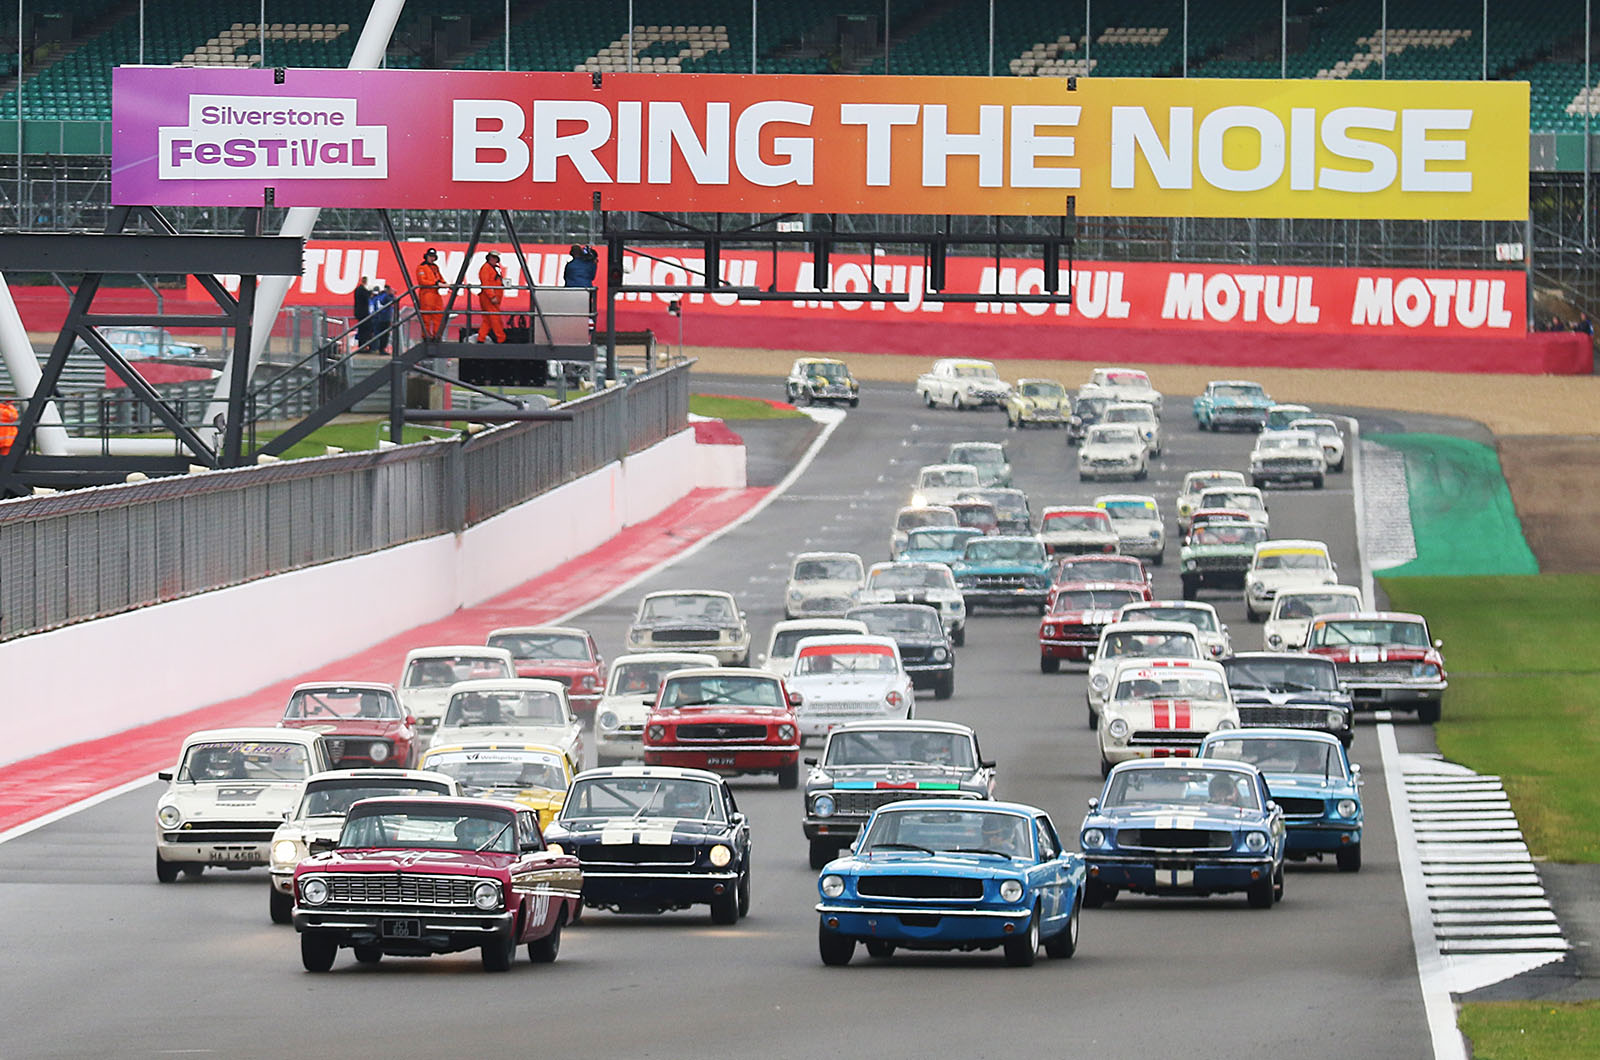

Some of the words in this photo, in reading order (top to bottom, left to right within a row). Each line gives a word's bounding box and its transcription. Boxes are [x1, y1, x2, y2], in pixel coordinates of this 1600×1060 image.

[201, 106, 345, 126] Silverstone
[452, 99, 814, 187] BRING
[840, 103, 1082, 188] THE
[1110, 105, 1473, 193] NOISE
[614, 256, 761, 306] MOTUL
[975, 267, 1131, 319] MOTUL
[1161, 272, 1320, 324] MOTUL
[1351, 277, 1512, 328] MOTUL
